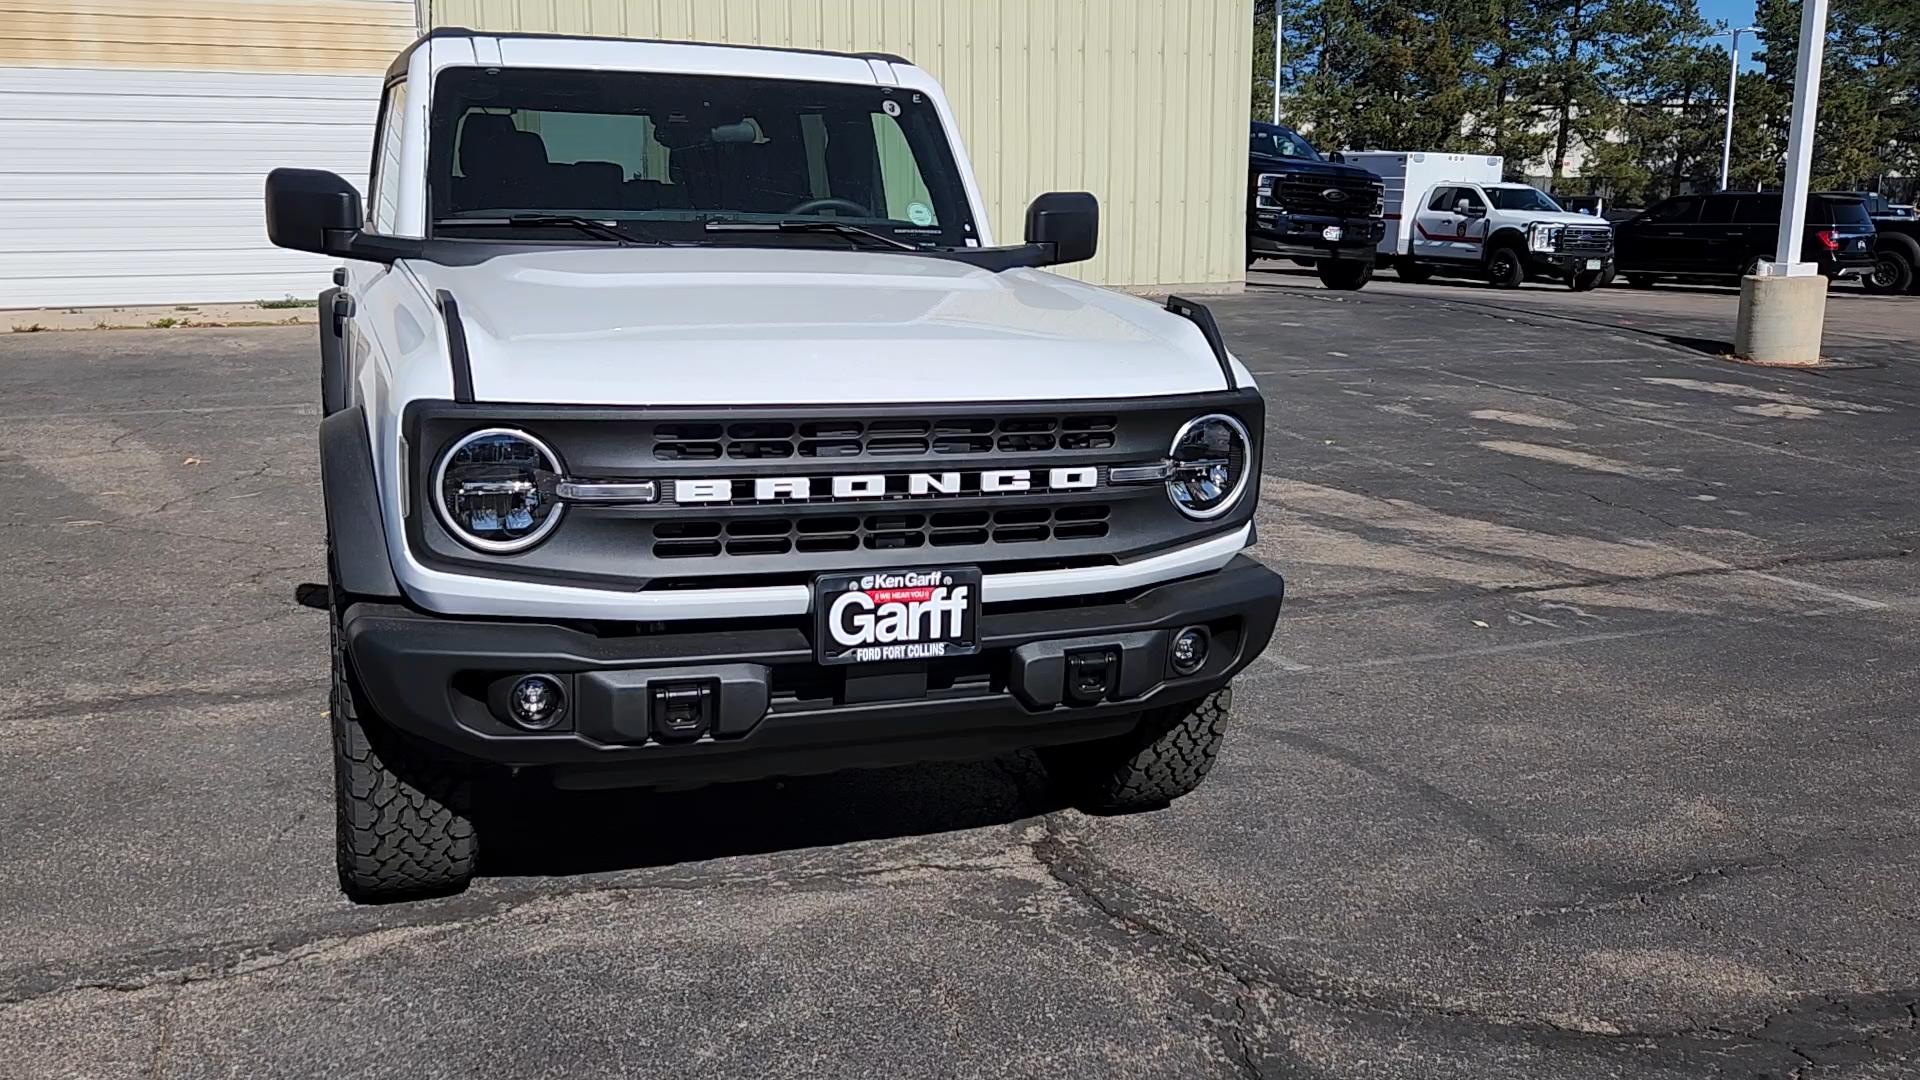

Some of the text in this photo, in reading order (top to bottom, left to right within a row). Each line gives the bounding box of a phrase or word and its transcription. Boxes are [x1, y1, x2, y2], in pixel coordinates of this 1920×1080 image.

[674, 466, 1098, 503] BRONCO
[875, 571, 942, 589] Ken Garff
[880, 589, 925, 600] WE HEAR YOU
[829, 586, 968, 646] Garff
[856, 642, 945, 662] FORD FORT COLLINS
